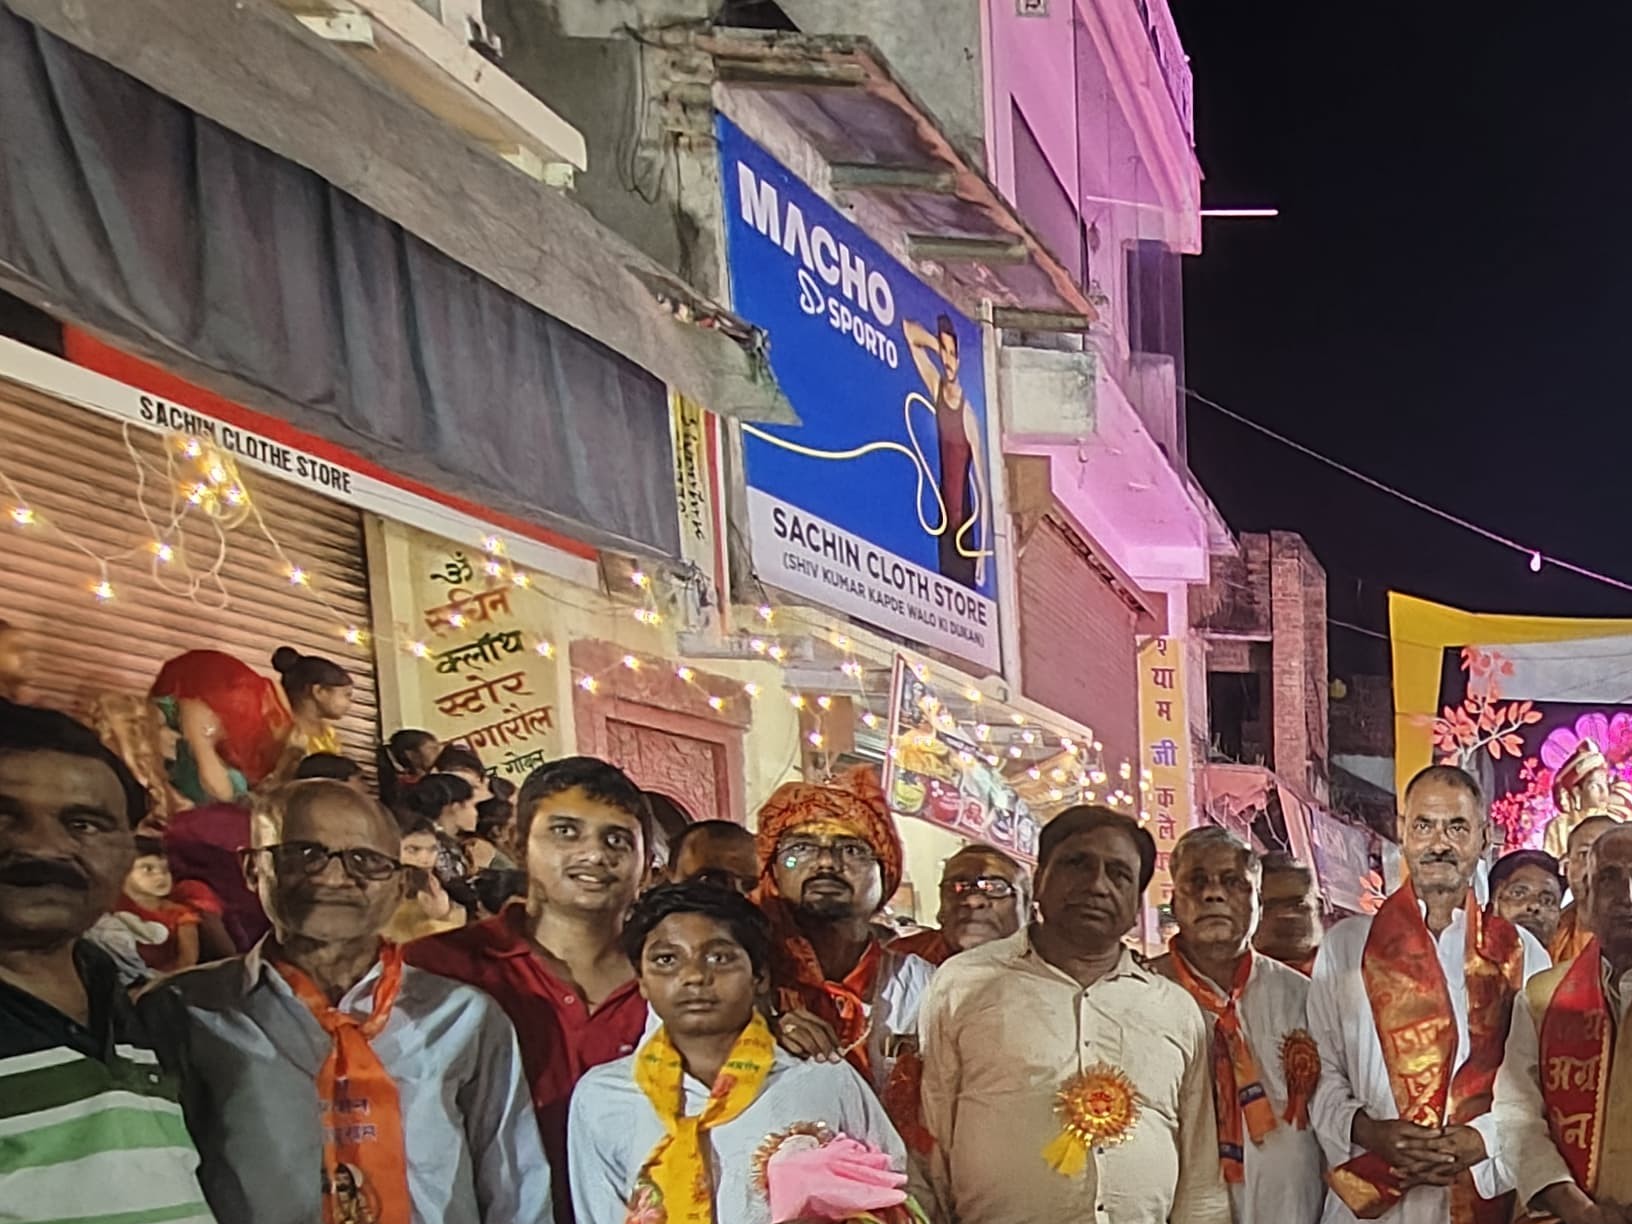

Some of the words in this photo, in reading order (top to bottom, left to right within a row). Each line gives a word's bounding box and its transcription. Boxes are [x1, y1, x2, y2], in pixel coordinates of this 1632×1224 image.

[737, 160, 894, 326] MACHO
[828, 297, 898, 369] SPORTO
[140, 395, 216, 440] SACHIN
[222, 427, 293, 472] CLOTHE
[297, 455, 352, 494] STORE
[773, 507, 860, 572] SACHIN
[867, 551, 930, 601] CLOTH
[934, 581, 988, 626] STORE
[783, 552, 819, 579] (SHIV
[822, 568, 866, 599] KUMAR
[868, 588, 905, 616] KAPDE
[907, 604, 937, 628] WALO
[435, 671, 534, 717] स्टोर
